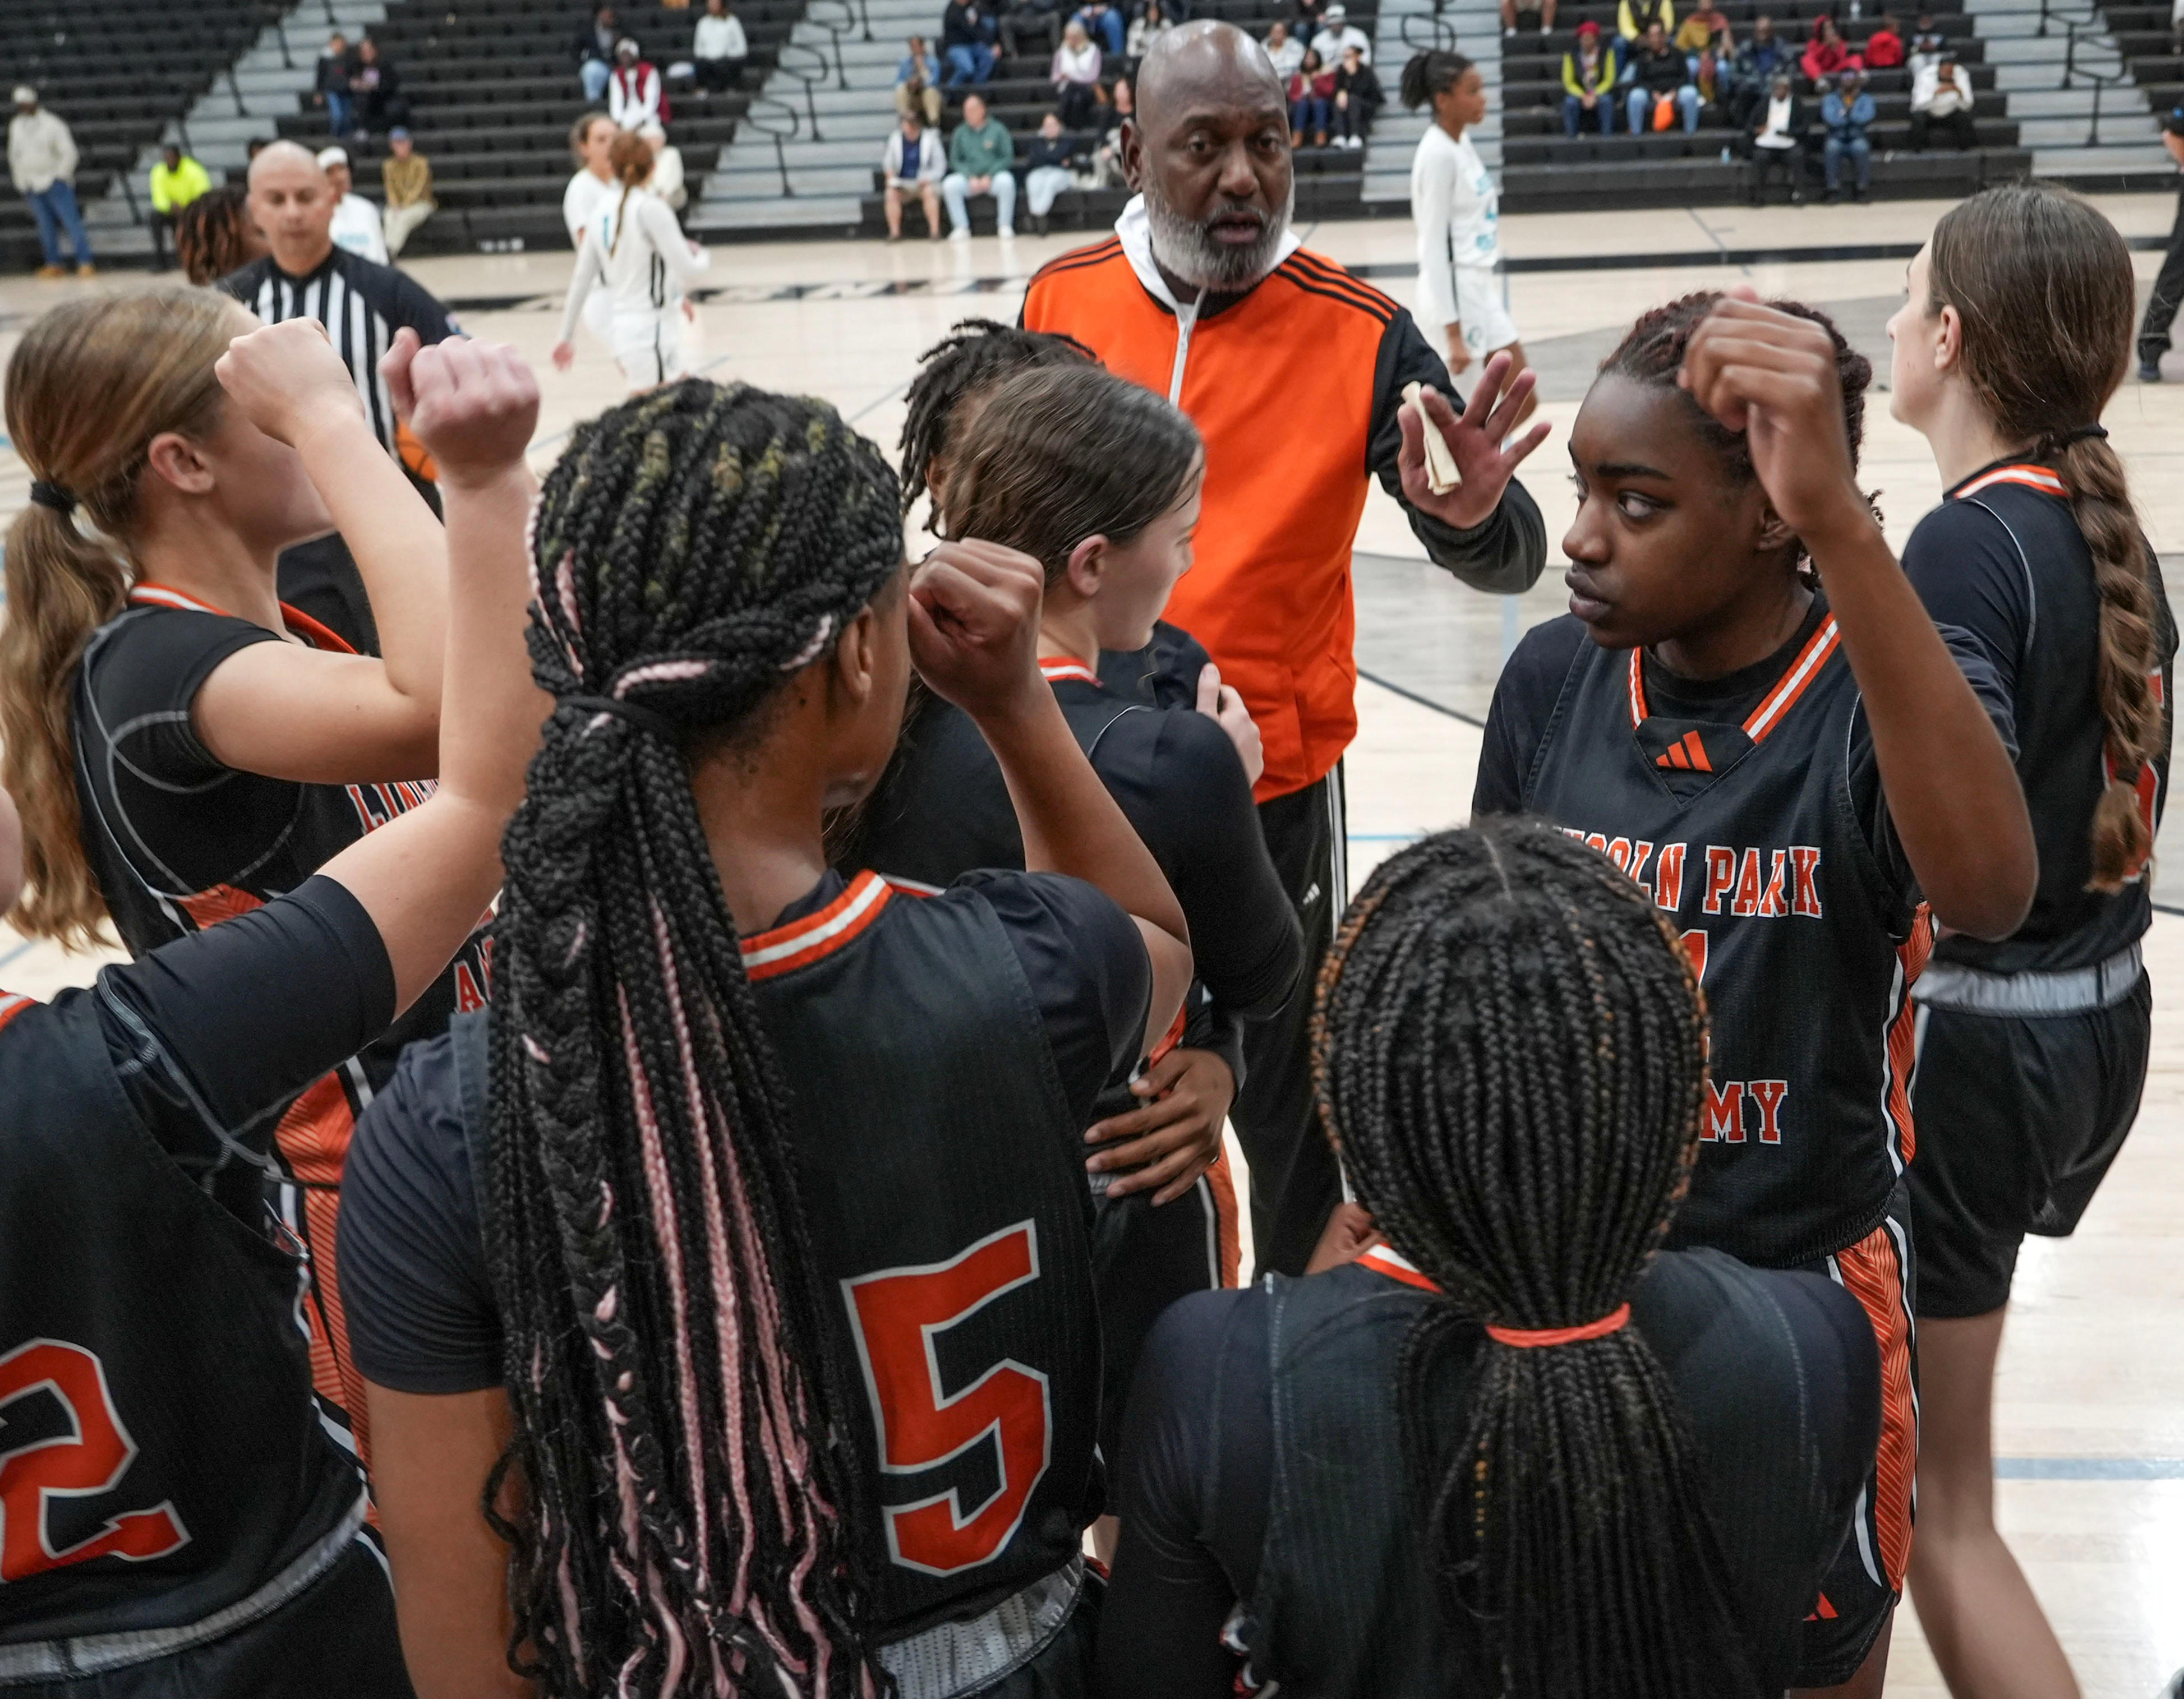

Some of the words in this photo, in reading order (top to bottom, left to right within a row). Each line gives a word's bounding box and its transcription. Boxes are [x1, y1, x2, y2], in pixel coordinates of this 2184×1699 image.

[1702, 844, 1822, 919] PARK
[1698, 1078, 1789, 1144] MY
[0, 1337, 193, 1583] 2
[840, 1217, 1053, 1577] 5
